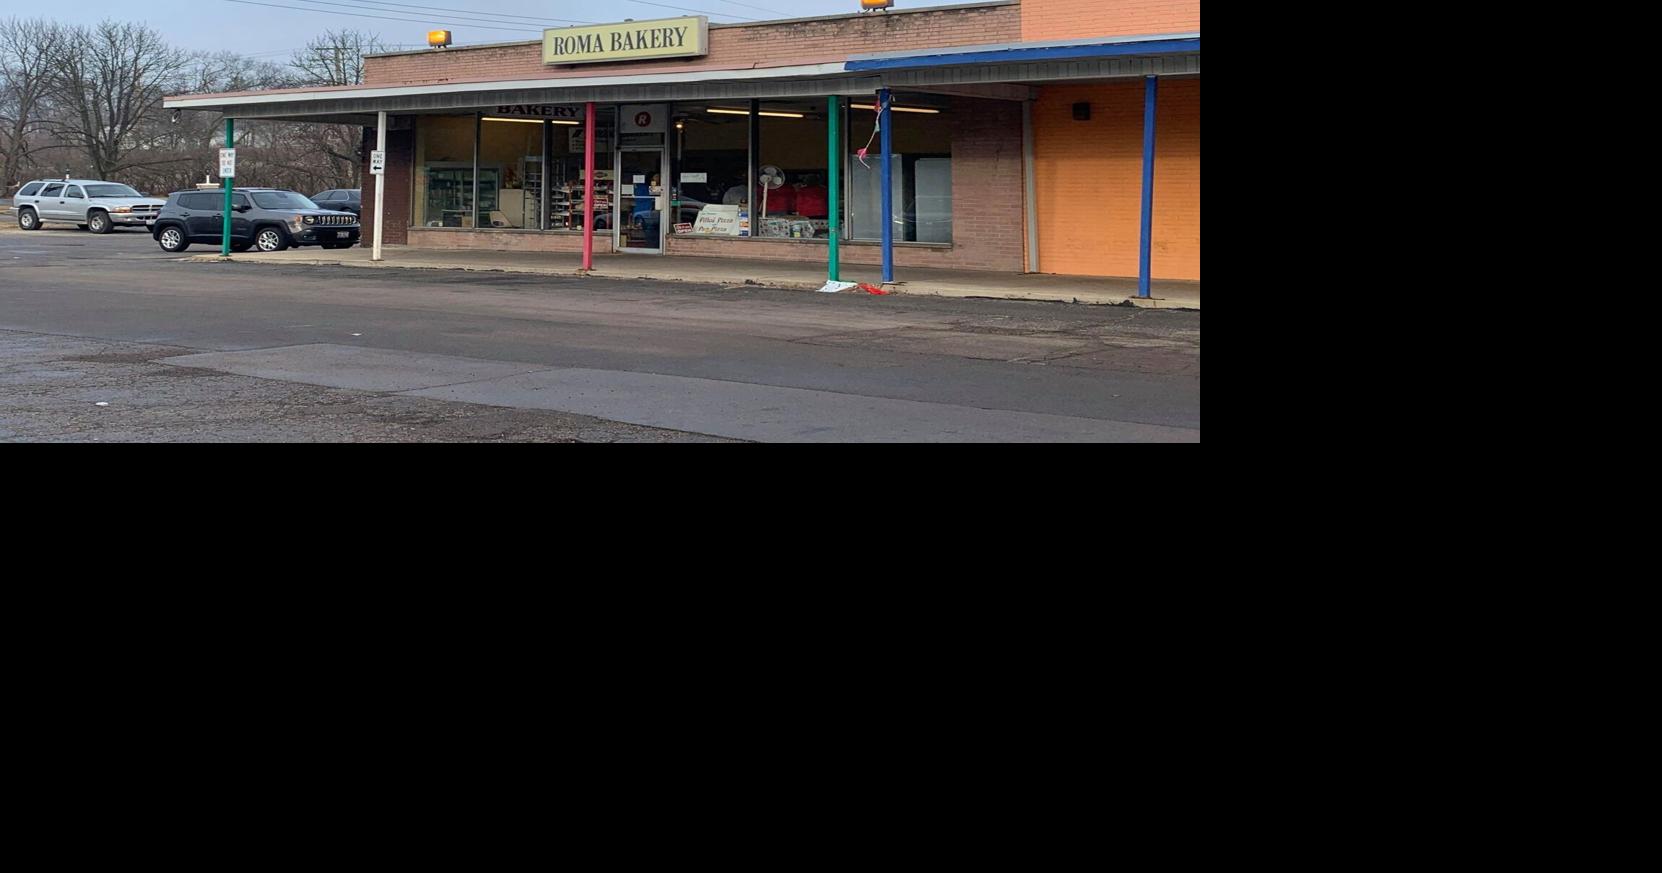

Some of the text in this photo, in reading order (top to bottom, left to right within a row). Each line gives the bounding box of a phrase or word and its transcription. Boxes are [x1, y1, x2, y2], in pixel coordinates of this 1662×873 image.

[553, 26, 688, 56] ROMA BAKERY
[496, 104, 580, 118] BAKERY
